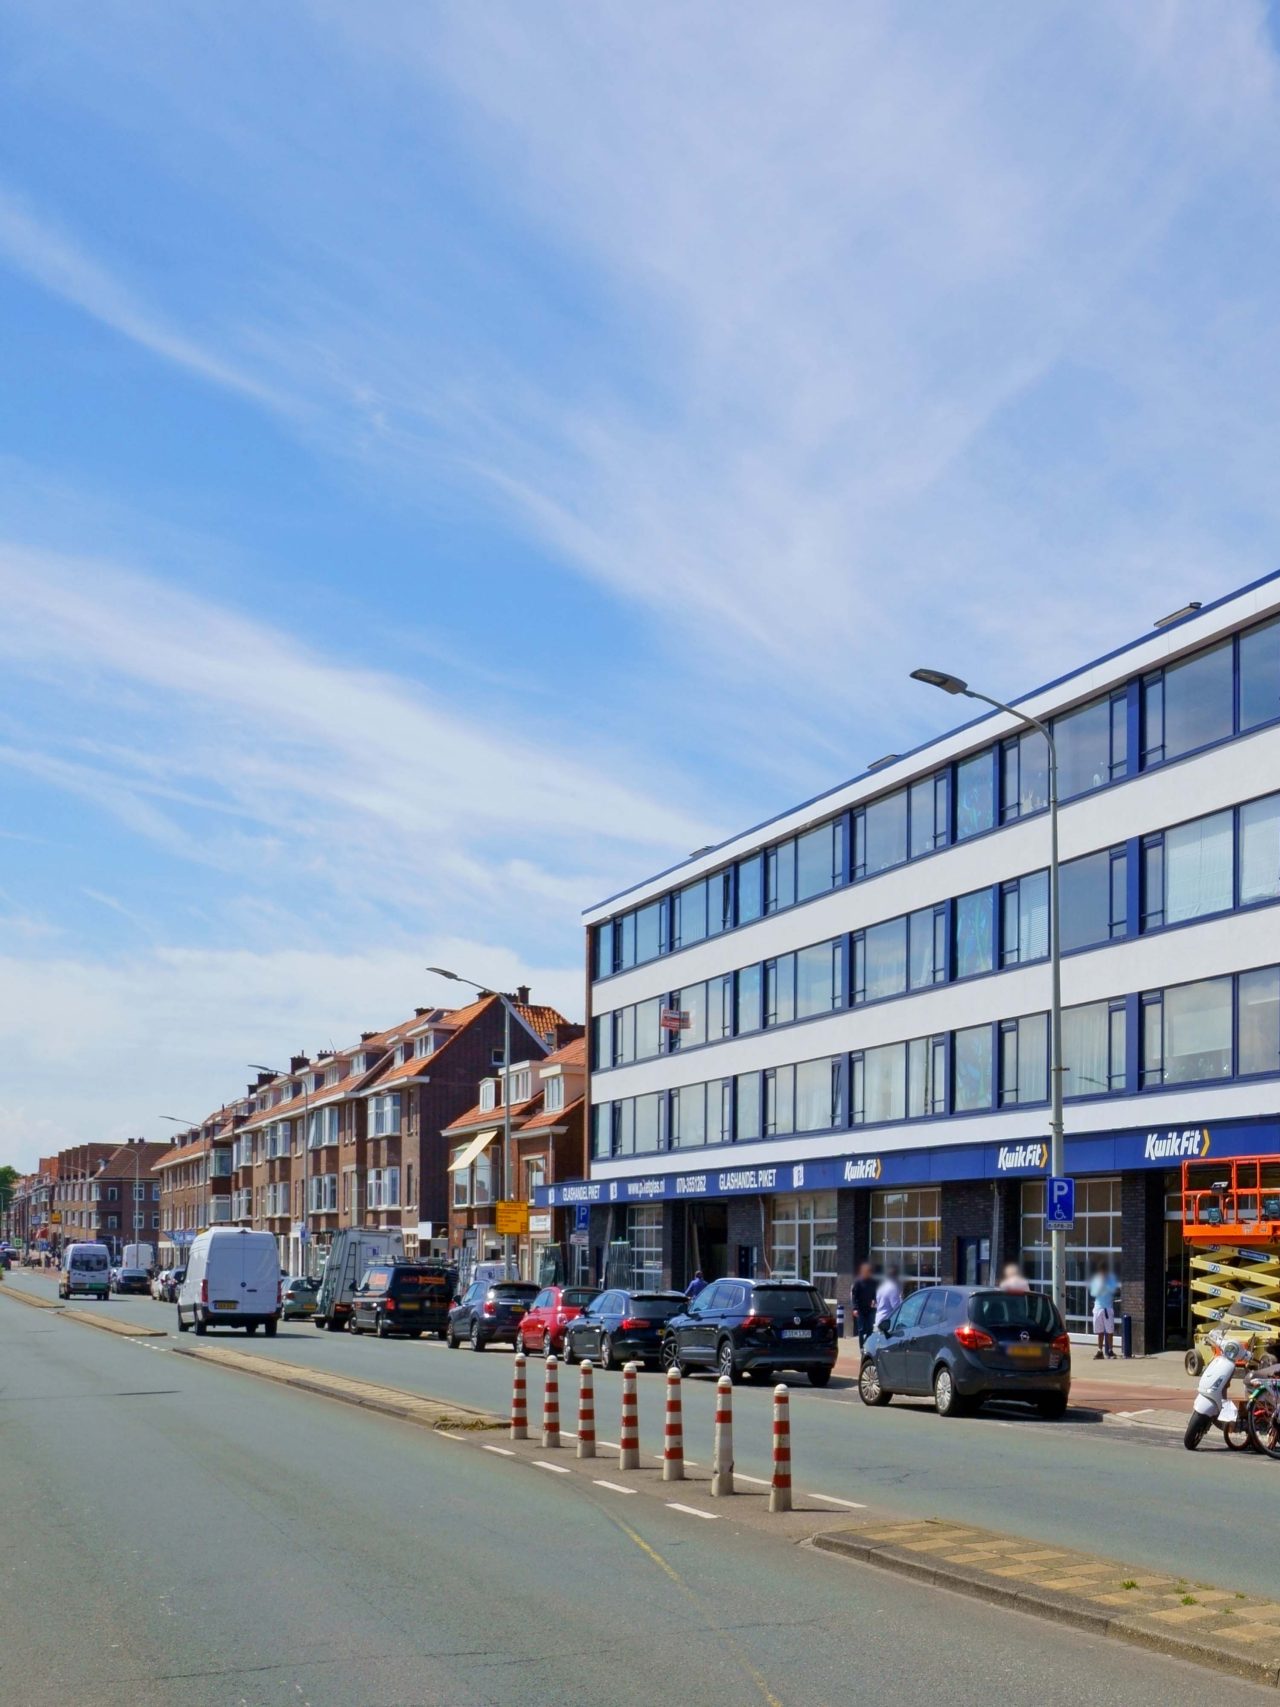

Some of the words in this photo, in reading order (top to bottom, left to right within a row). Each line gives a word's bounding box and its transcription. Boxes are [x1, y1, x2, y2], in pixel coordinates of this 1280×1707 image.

[1145, 1130, 1200, 1160] KwikFit
[997, 1144, 1043, 1170] KwikFit
[719, 1171, 757, 1190] GLASHANDEL
[758, 1169, 776, 1188] PIKET
[844, 1158, 877, 1181] KwikFit
[1053, 1181, 1068, 1204] P
[580, 1207, 587, 1220] P
